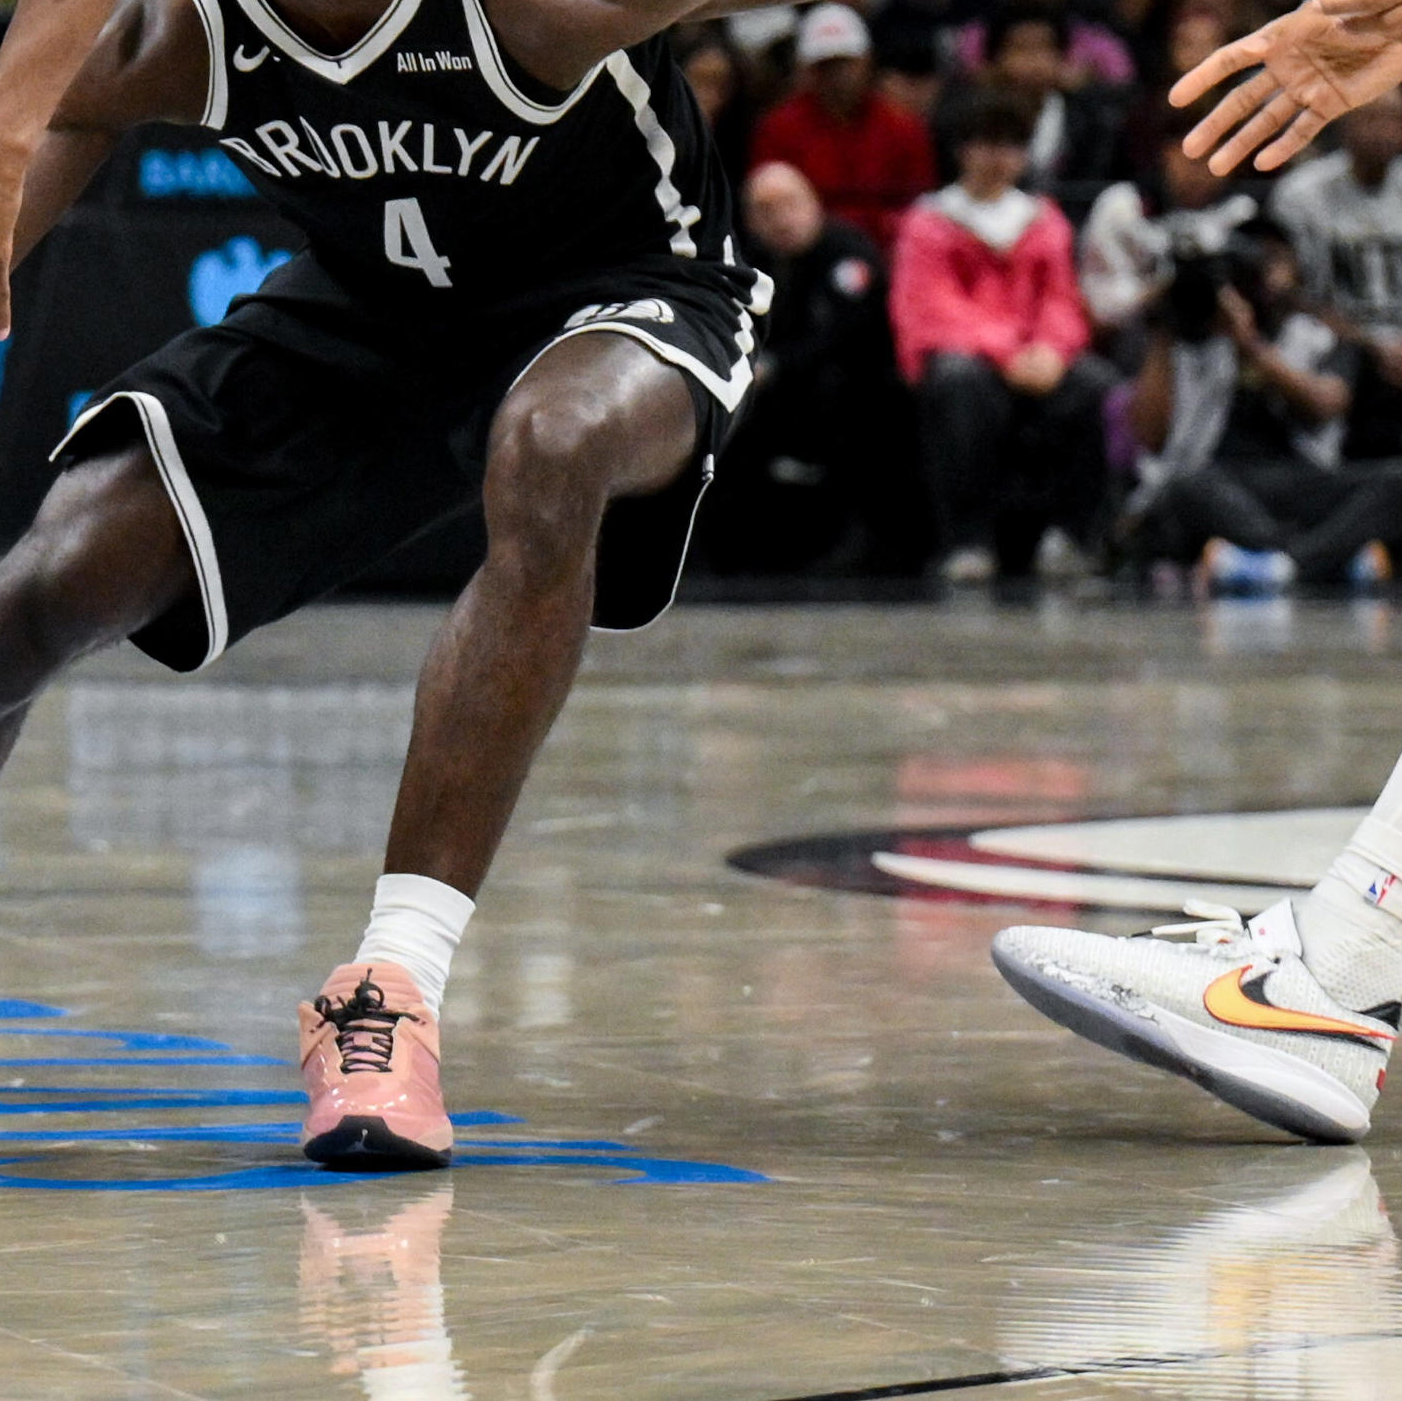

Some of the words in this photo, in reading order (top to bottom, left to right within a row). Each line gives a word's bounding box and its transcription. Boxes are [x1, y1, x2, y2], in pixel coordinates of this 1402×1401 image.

[397, 52, 418, 73] All
[418, 52, 436, 72] In
[435, 50, 473, 71] Won
[218, 115, 541, 186] BROOKLYN
[384, 197, 453, 288] 4
